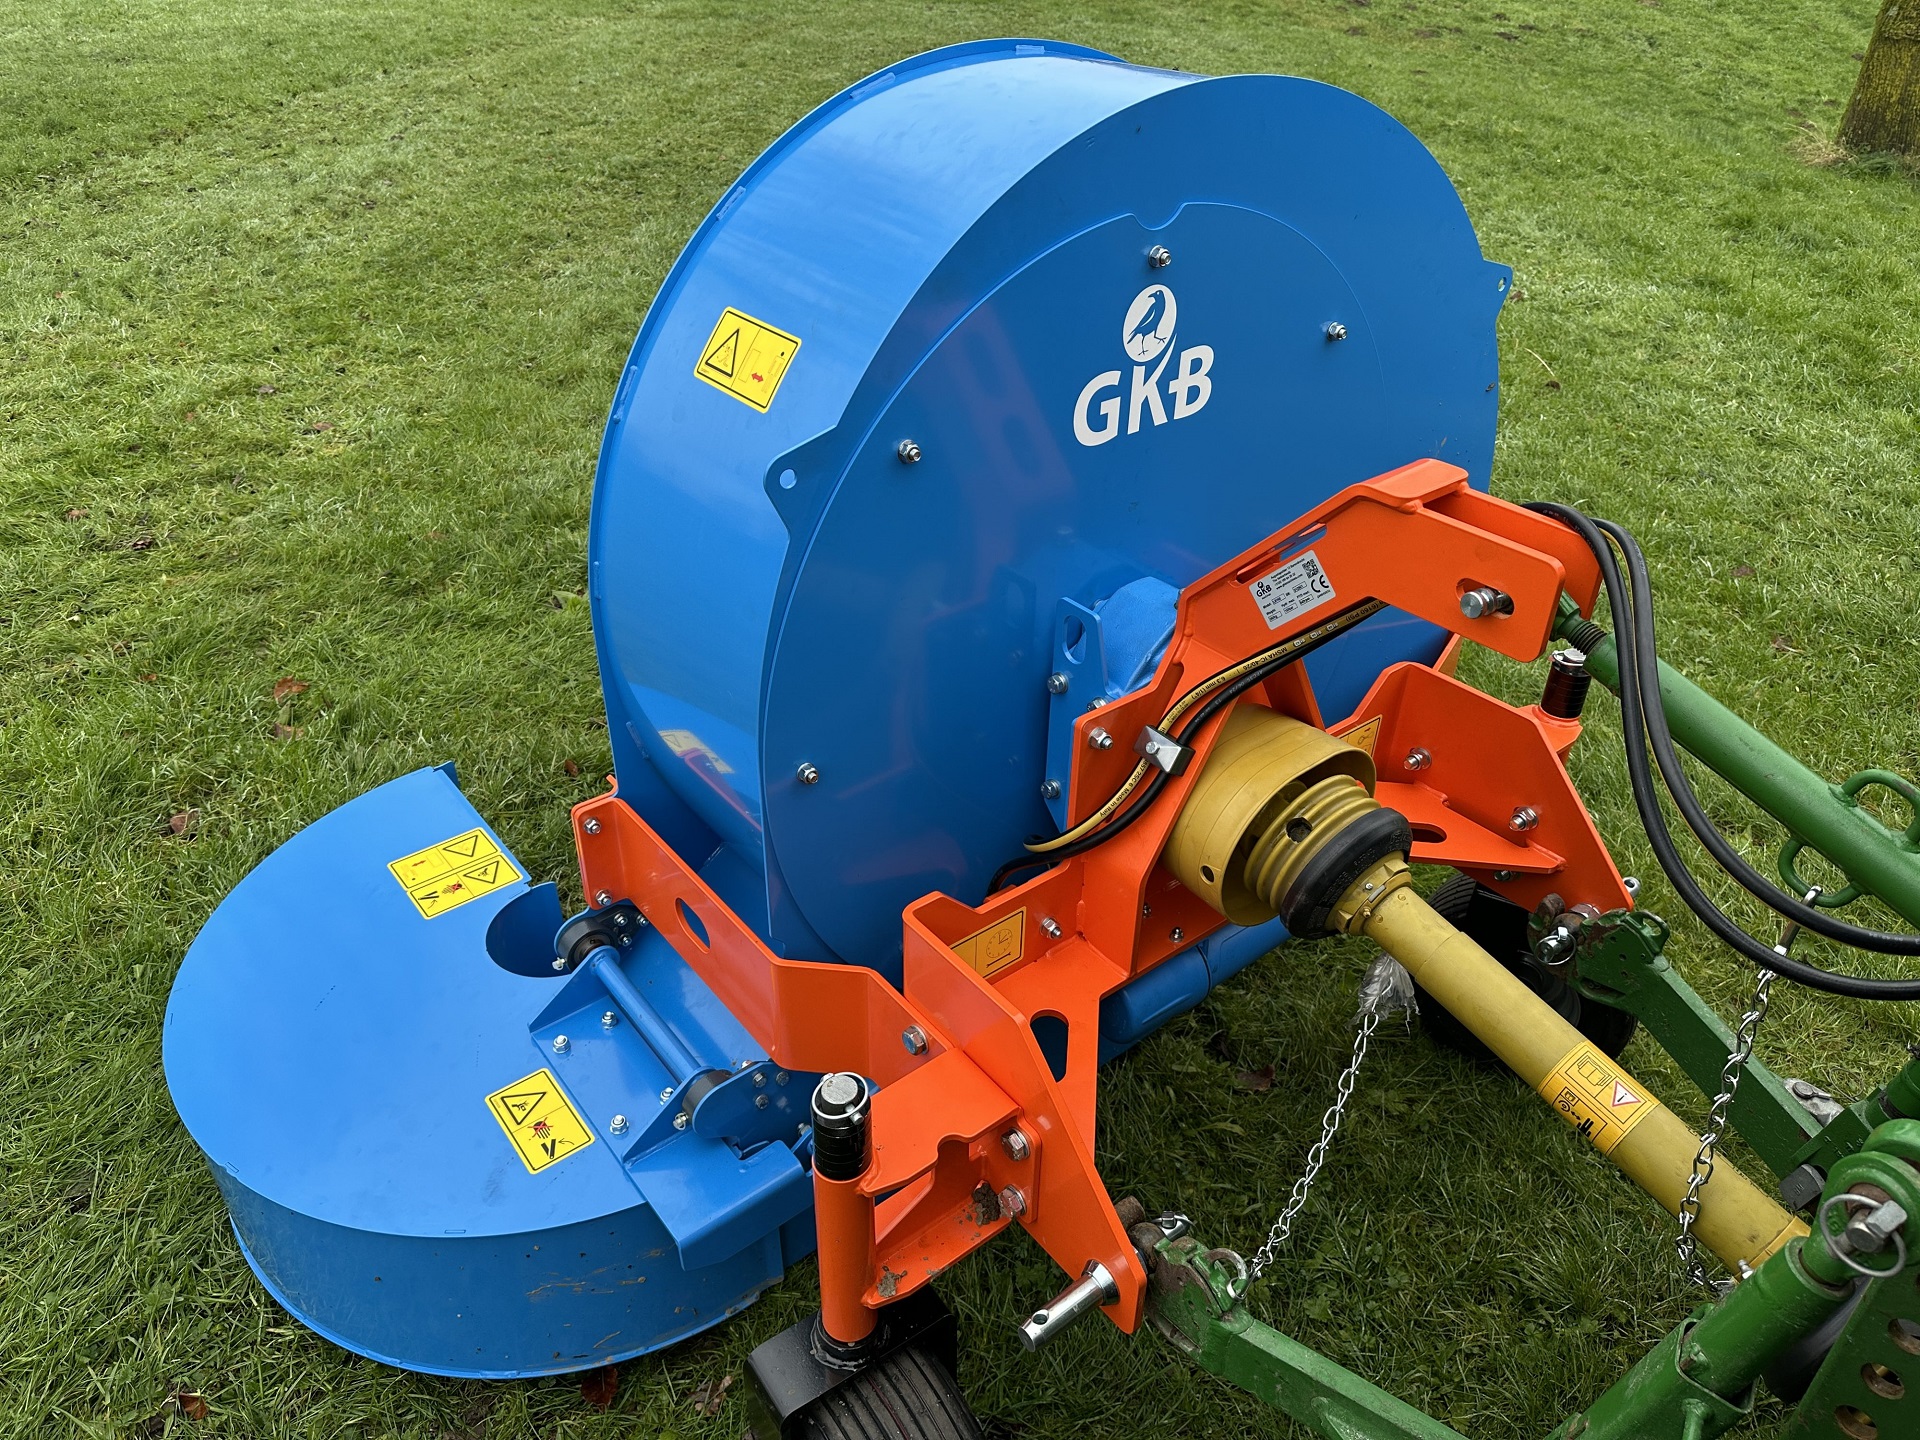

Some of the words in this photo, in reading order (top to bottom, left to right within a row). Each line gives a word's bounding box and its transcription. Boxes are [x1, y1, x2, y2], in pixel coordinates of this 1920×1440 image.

[1073, 333, 1215, 447] GKB
[1311, 575, 1329, 592] CE
[1257, 585, 1272, 597] GKB
[1267, 647, 1287, 659] MSHA
[1205, 681, 1216, 689] mm
[1132, 771, 1141, 782] 2SC
[1116, 788, 1129, 802] Made
[1100, 807, 1111, 817] Italy
